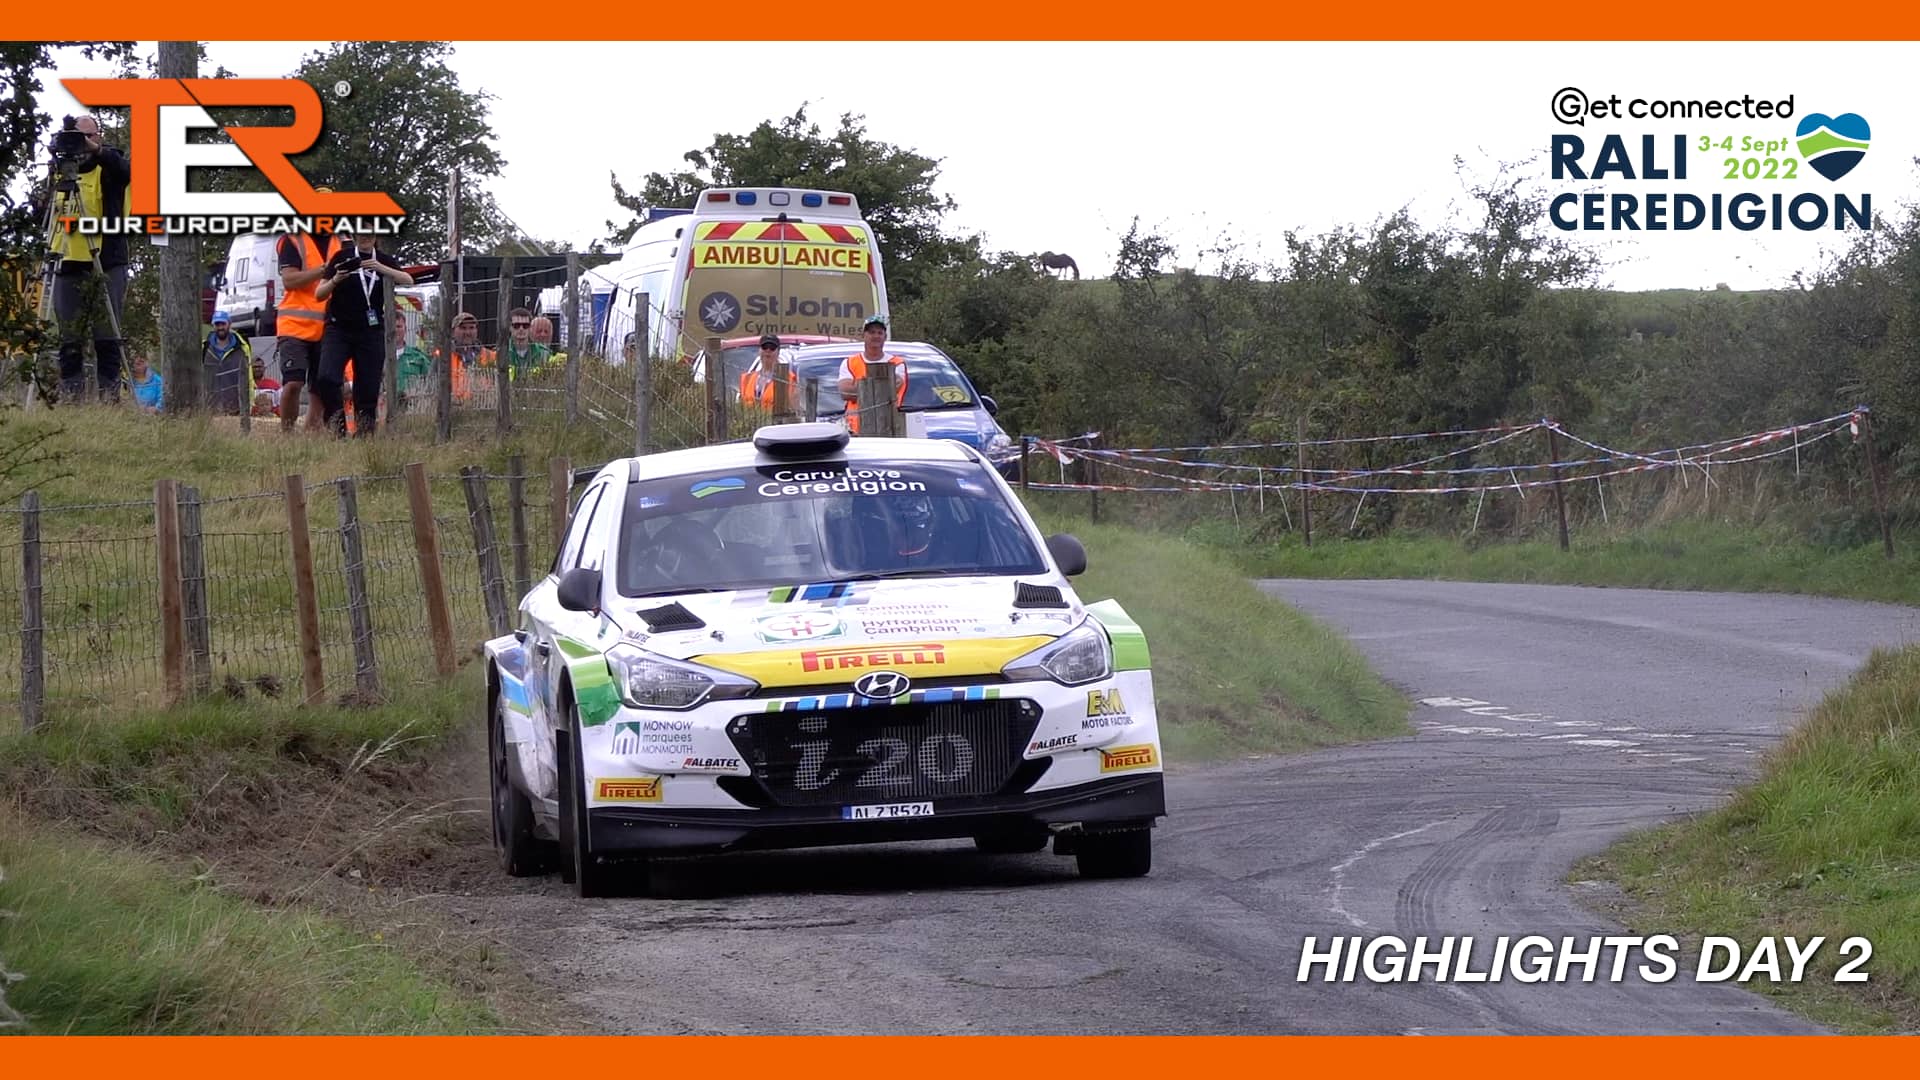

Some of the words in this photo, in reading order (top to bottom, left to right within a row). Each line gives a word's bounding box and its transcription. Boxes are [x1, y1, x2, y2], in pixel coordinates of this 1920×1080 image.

[702, 245, 862, 268] AMBULANCE
[745, 294, 779, 316] St
[785, 296, 864, 318] John
[744, 320, 798, 335] Cymru
[816, 322, 864, 336] Wales
[758, 477, 927, 497] Ceredigion
[864, 624, 959, 635] Cambrian
[801, 643, 945, 673] PIRELLI
[643, 720, 693, 731] MONNOW
[1081, 717, 1109, 729] MOTOR
[643, 733, 692, 744] marquees
[1036, 734, 1078, 749] ALBATEC
[690, 758, 740, 767] ALBATEC
[1104, 748, 1152, 769] PIRELLI
[600, 783, 657, 798] PIRELLI
